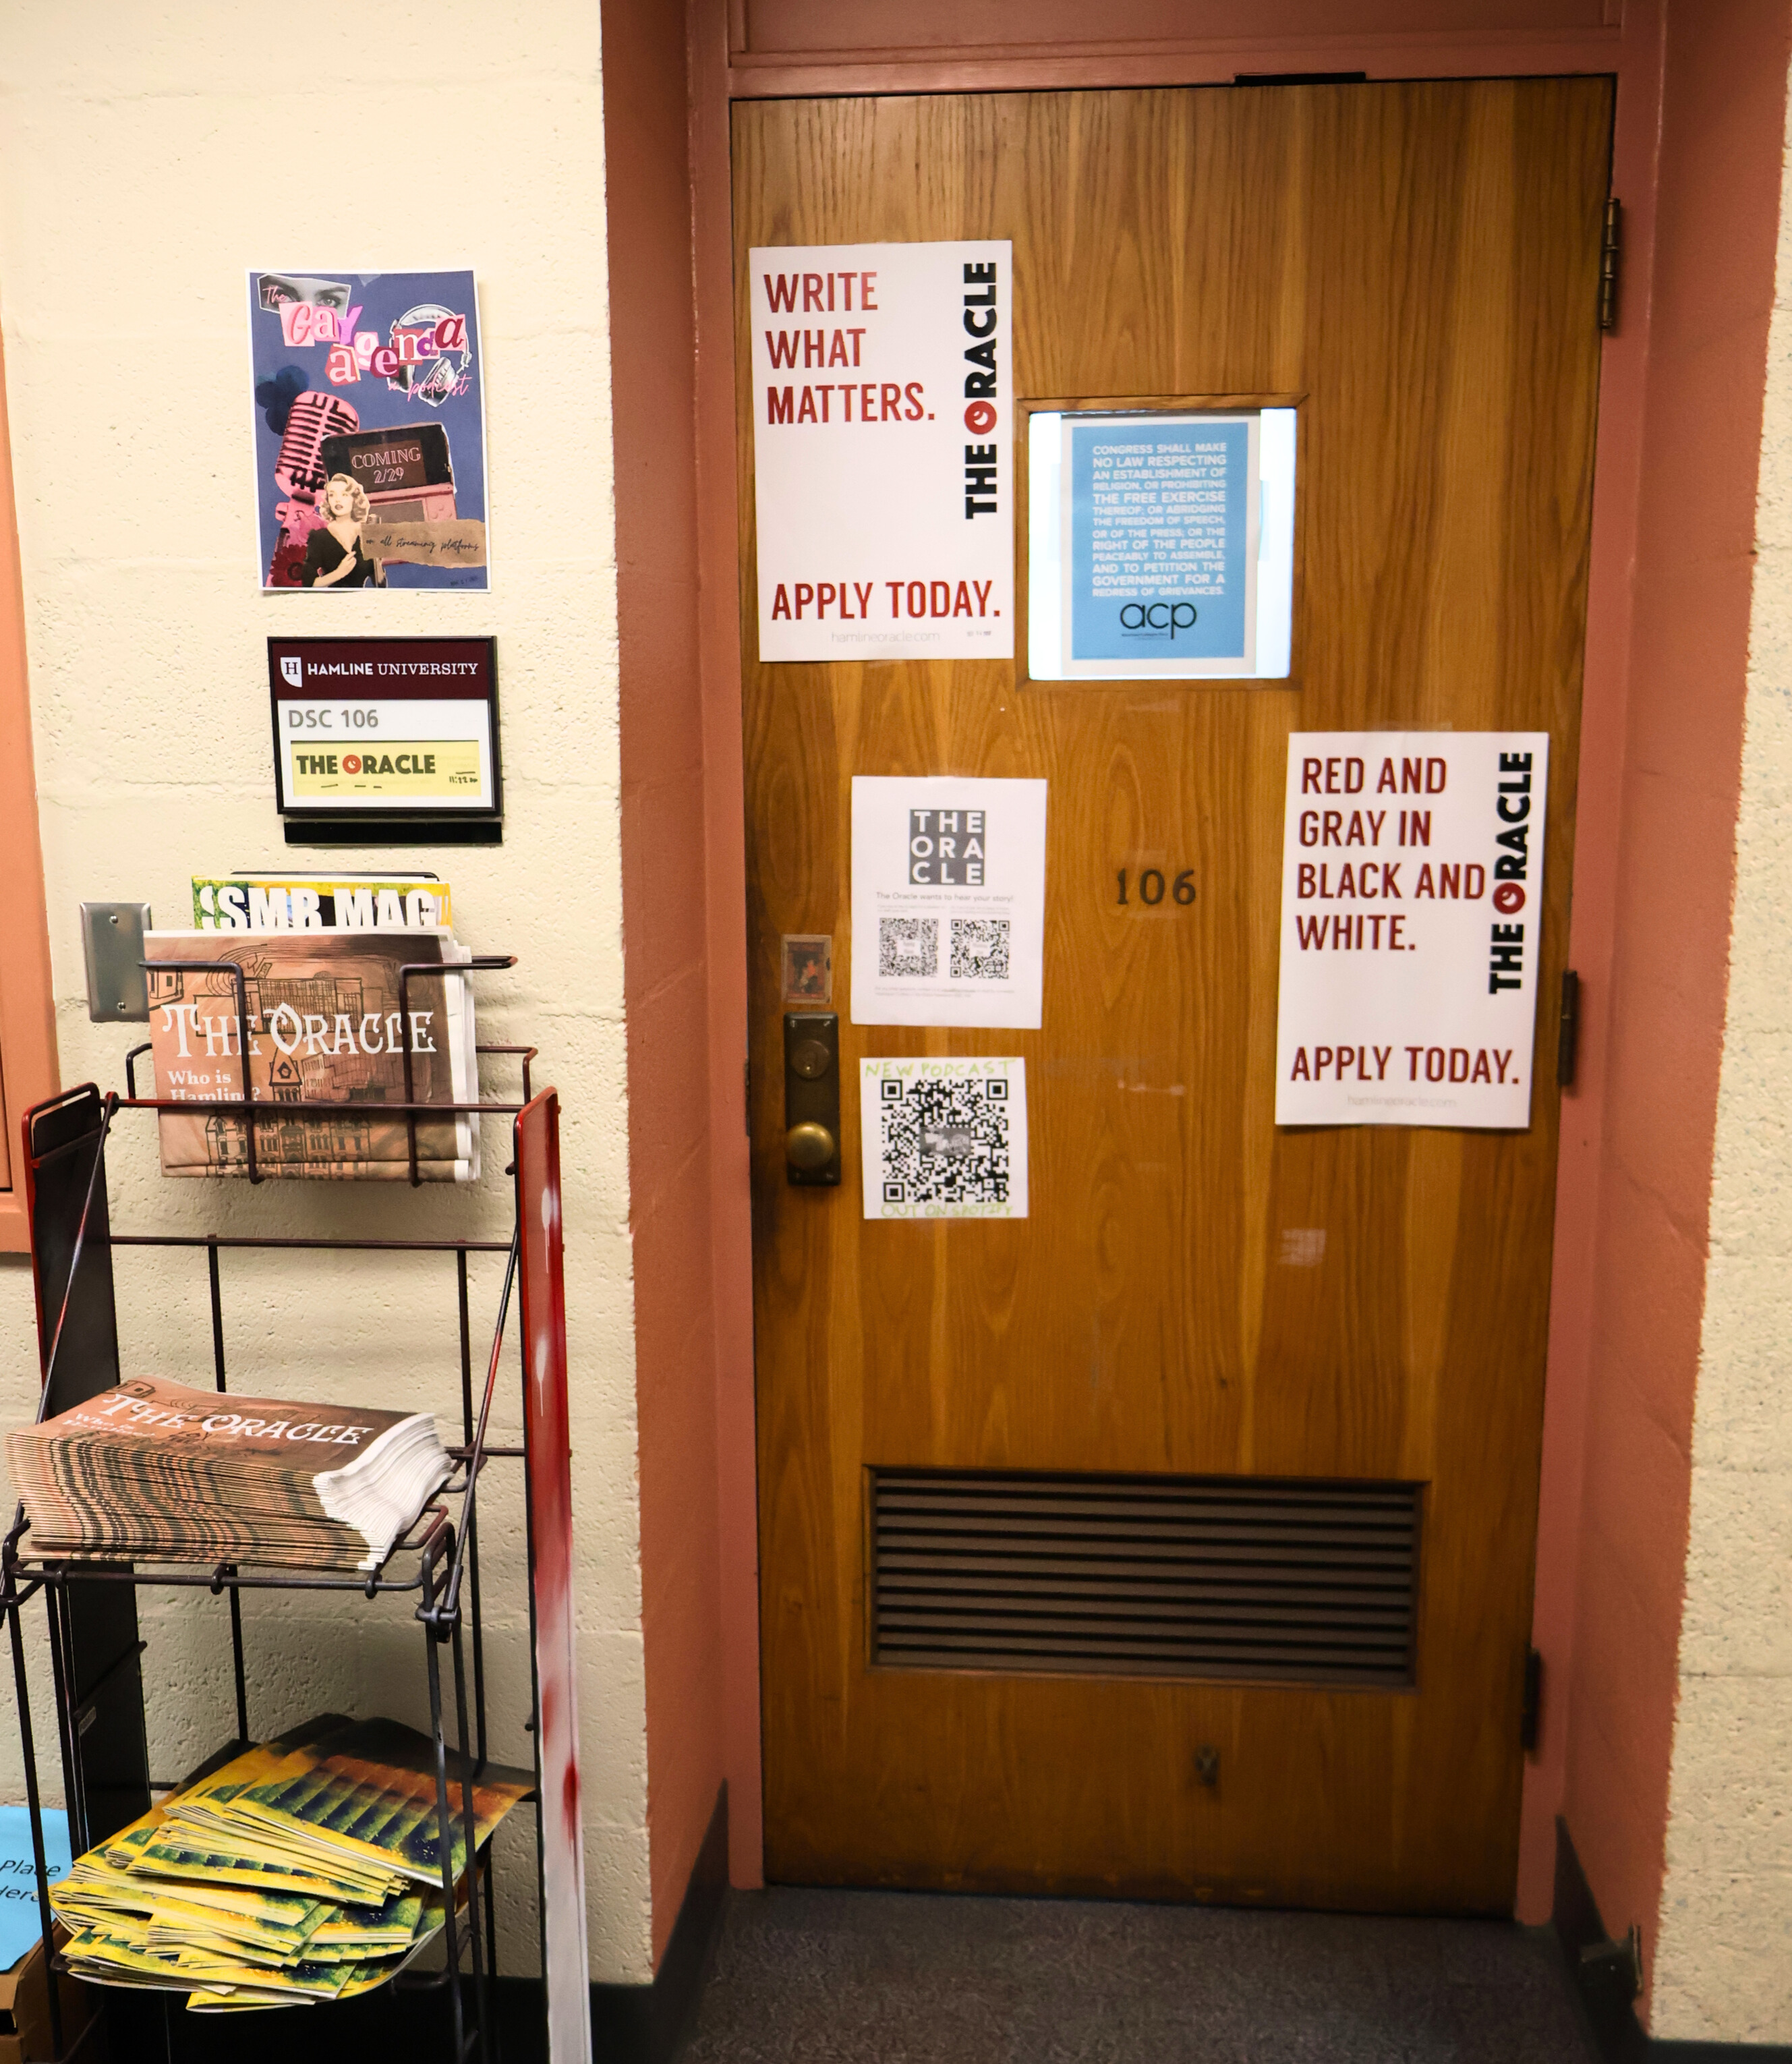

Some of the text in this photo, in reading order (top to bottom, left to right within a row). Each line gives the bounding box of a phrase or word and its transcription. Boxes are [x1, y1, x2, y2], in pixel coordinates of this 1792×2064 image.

[262, 286, 288, 304] The
[763, 272, 878, 313] WRITE
[765, 328, 866, 369] WHAT
[964, 262, 997, 519] THE ORACLE
[767, 382, 935, 424] MATTERS.
[351, 447, 421, 468] COMING
[1093, 442, 1227, 455] CONGRESS SHALL MAKE
[1093, 455, 1226, 467] NO LAW RESPECTING
[374, 467, 404, 484] 2/29
[1093, 467, 1226, 480] AN ESTABLISHMENT OF
[1144, 481, 1159, 489] OR
[1161, 480, 1226, 489] PROHIBITING
[1093, 491, 1225, 504] THE FREE EXERCISE
[1147, 506, 1163, 514] OR
[1166, 505, 1225, 514] ABRIDGING
[1093, 517, 1111, 526] THE
[1115, 517, 1163, 525] FREEDOM
[1166, 517, 1182, 525] OF
[1093, 530, 1107, 538] OR
[1110, 529, 1124, 538] OF
[1128, 529, 1147, 538] THE
[1188, 528, 1202, 536] OR
[1206, 527, 1225, 536] THE
[380, 536, 391, 546] all
[396, 538, 436, 553] streaming
[440, 539, 479, 553] platforms
[1093, 538, 1225, 550] RIGHT OF THE PEOPLE
[1093, 552, 1149, 561] PEACEABLY
[1153, 552, 1166, 560] TO
[1093, 562, 1225, 573] AND TO PETITION THE
[1093, 574, 1225, 586] GOVERNMENT FOR A
[772, 580, 1001, 621] APPLY TODAY.
[1093, 588, 1138, 597] REDRESS
[1140, 587, 1155, 596] OF
[1120, 602, 1197, 640] acp
[308, 663, 373, 675] HAMLINE
[378, 663, 478, 675] UNIVERSITY
[289, 710, 378, 728] DSC 106
[296, 755, 338, 775] THE
[343, 755, 436, 774] ORACLE
[1302, 757, 1447, 795] RED AND
[914, 811, 982, 834] THE
[1299, 810, 1431, 847] GRAY IN
[1297, 863, 1485, 900] BLACK AND
[1489, 752, 1532, 995] THE ORACLE
[892, 892, 917, 900] Oracle
[1116, 868, 1197, 906] 106
[334, 888, 436, 927] MAG
[1296, 915, 1416, 950] WHITE.
[263, 1002, 437, 1055] ORACLE
[865, 1059, 1017, 1079] NEW PODCAST
[1290, 1046, 1520, 1084] APPLY TODAY.
[168, 1069, 231, 1085] Who is
[170, 1087, 261, 1101] Hamlin?
[881, 1204, 921, 1217] OUT
[925, 1204, 948, 1217] ON
[99, 1394, 195, 1429] THE
[202, 1414, 374, 1444] ORACLE
[0, 1860, 61, 1876] Plae
